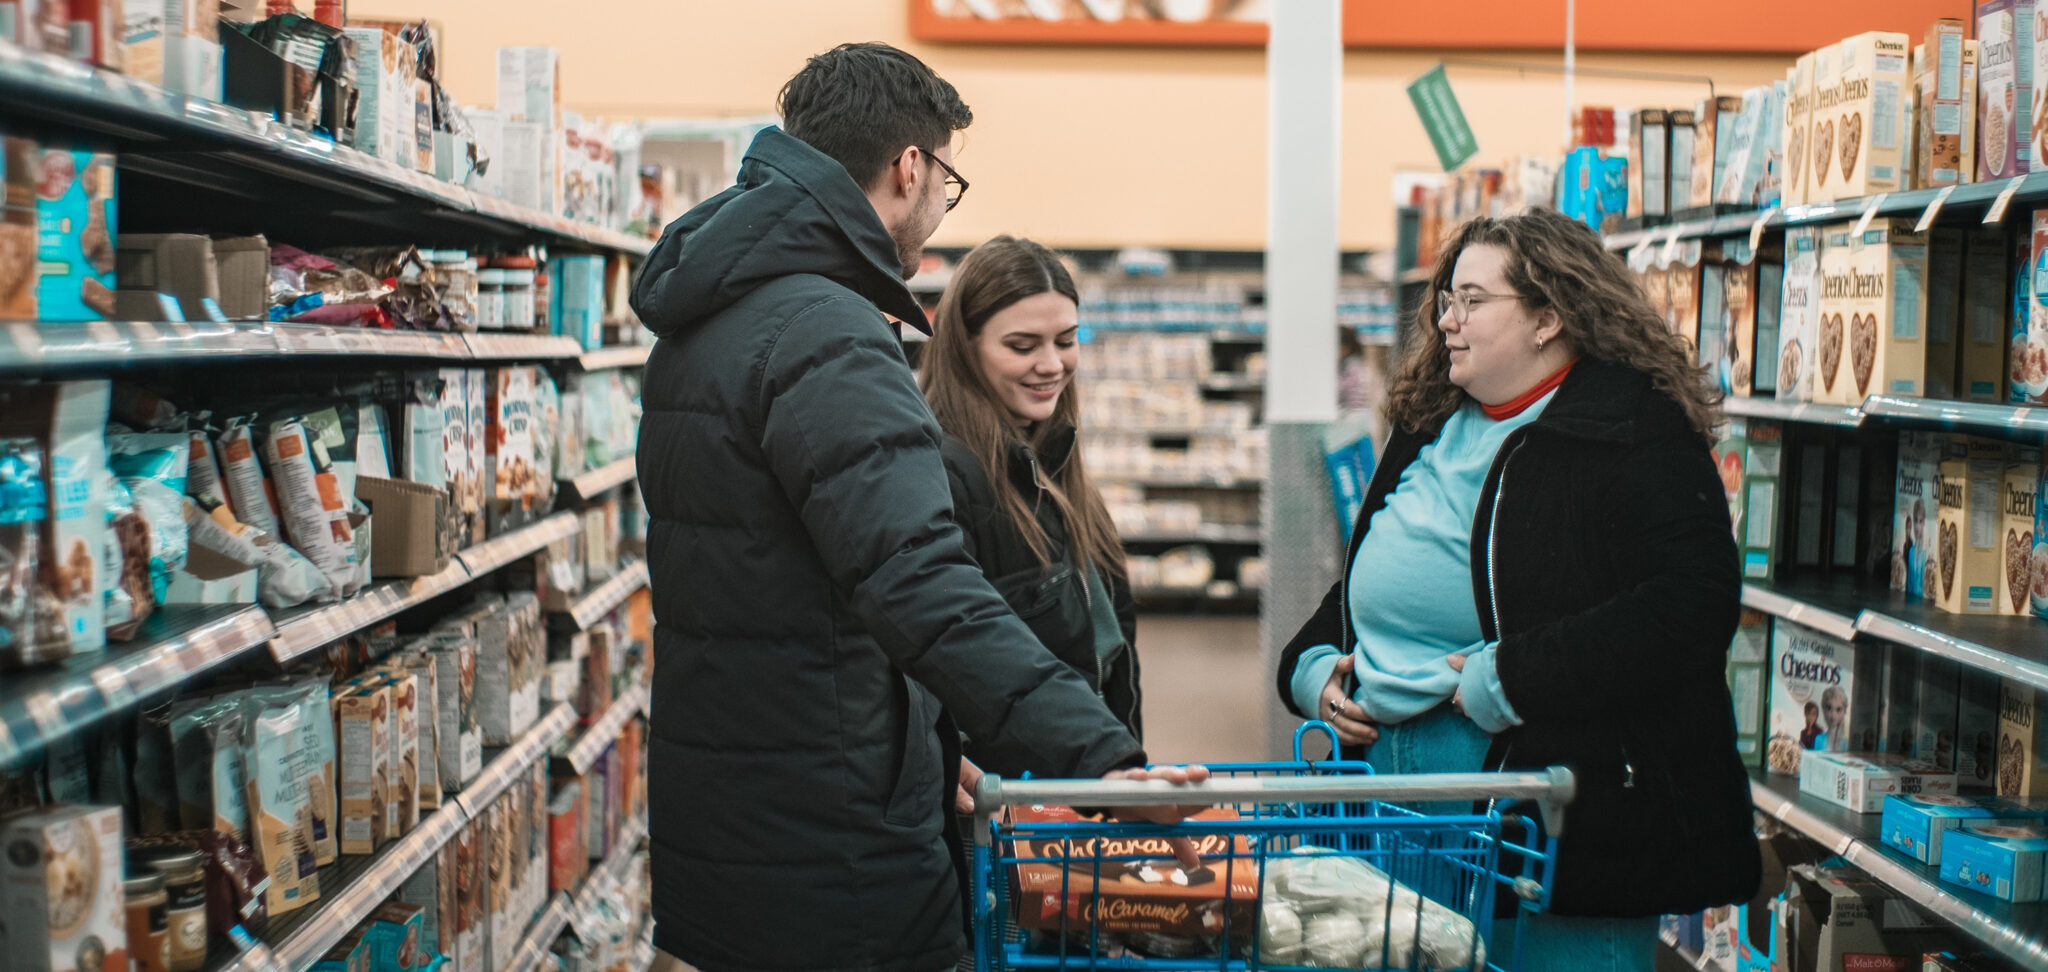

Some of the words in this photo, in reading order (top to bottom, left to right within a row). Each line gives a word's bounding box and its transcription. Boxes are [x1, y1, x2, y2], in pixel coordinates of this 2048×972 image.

[1874, 39, 1904, 51] Cheerios
[1979, 39, 2012, 70] Cheerios
[1850, 264, 1884, 299] Cheerios
[1781, 651, 1841, 686] Cheerios
[1901, 785, 1922, 794] CORN
[1109, 899, 1190, 924] Caramel!
